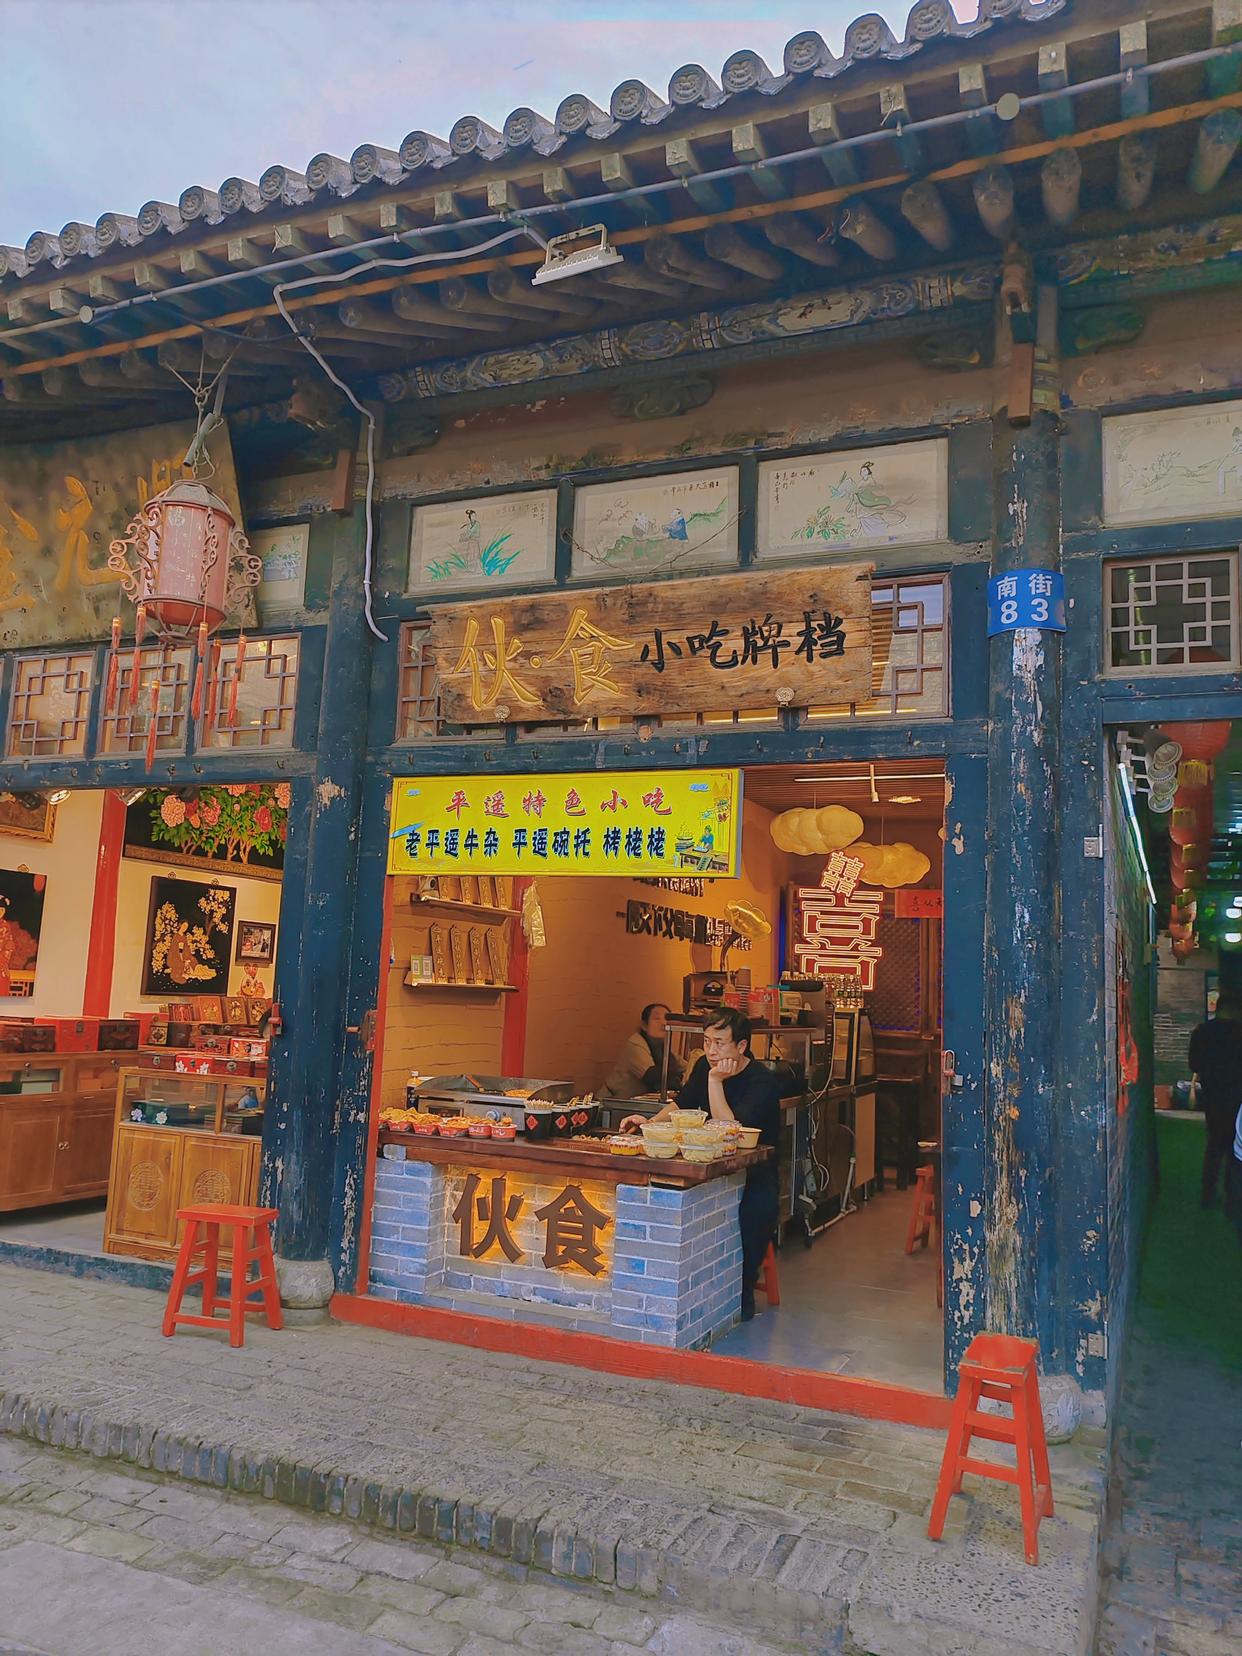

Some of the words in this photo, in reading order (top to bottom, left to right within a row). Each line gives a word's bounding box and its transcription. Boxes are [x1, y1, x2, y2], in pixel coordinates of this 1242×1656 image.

[996, 573, 1053, 600] 南街
[1000, 597, 1049, 624] 83
[640, 611, 847, 673] 小吃牌档
[445, 787, 673, 821] 平遥特色小吃
[405, 827, 499, 860] 老平遥牛杂
[512, 827, 591, 859] 平遥碗托
[452, 1172, 612, 1276] 伙食
